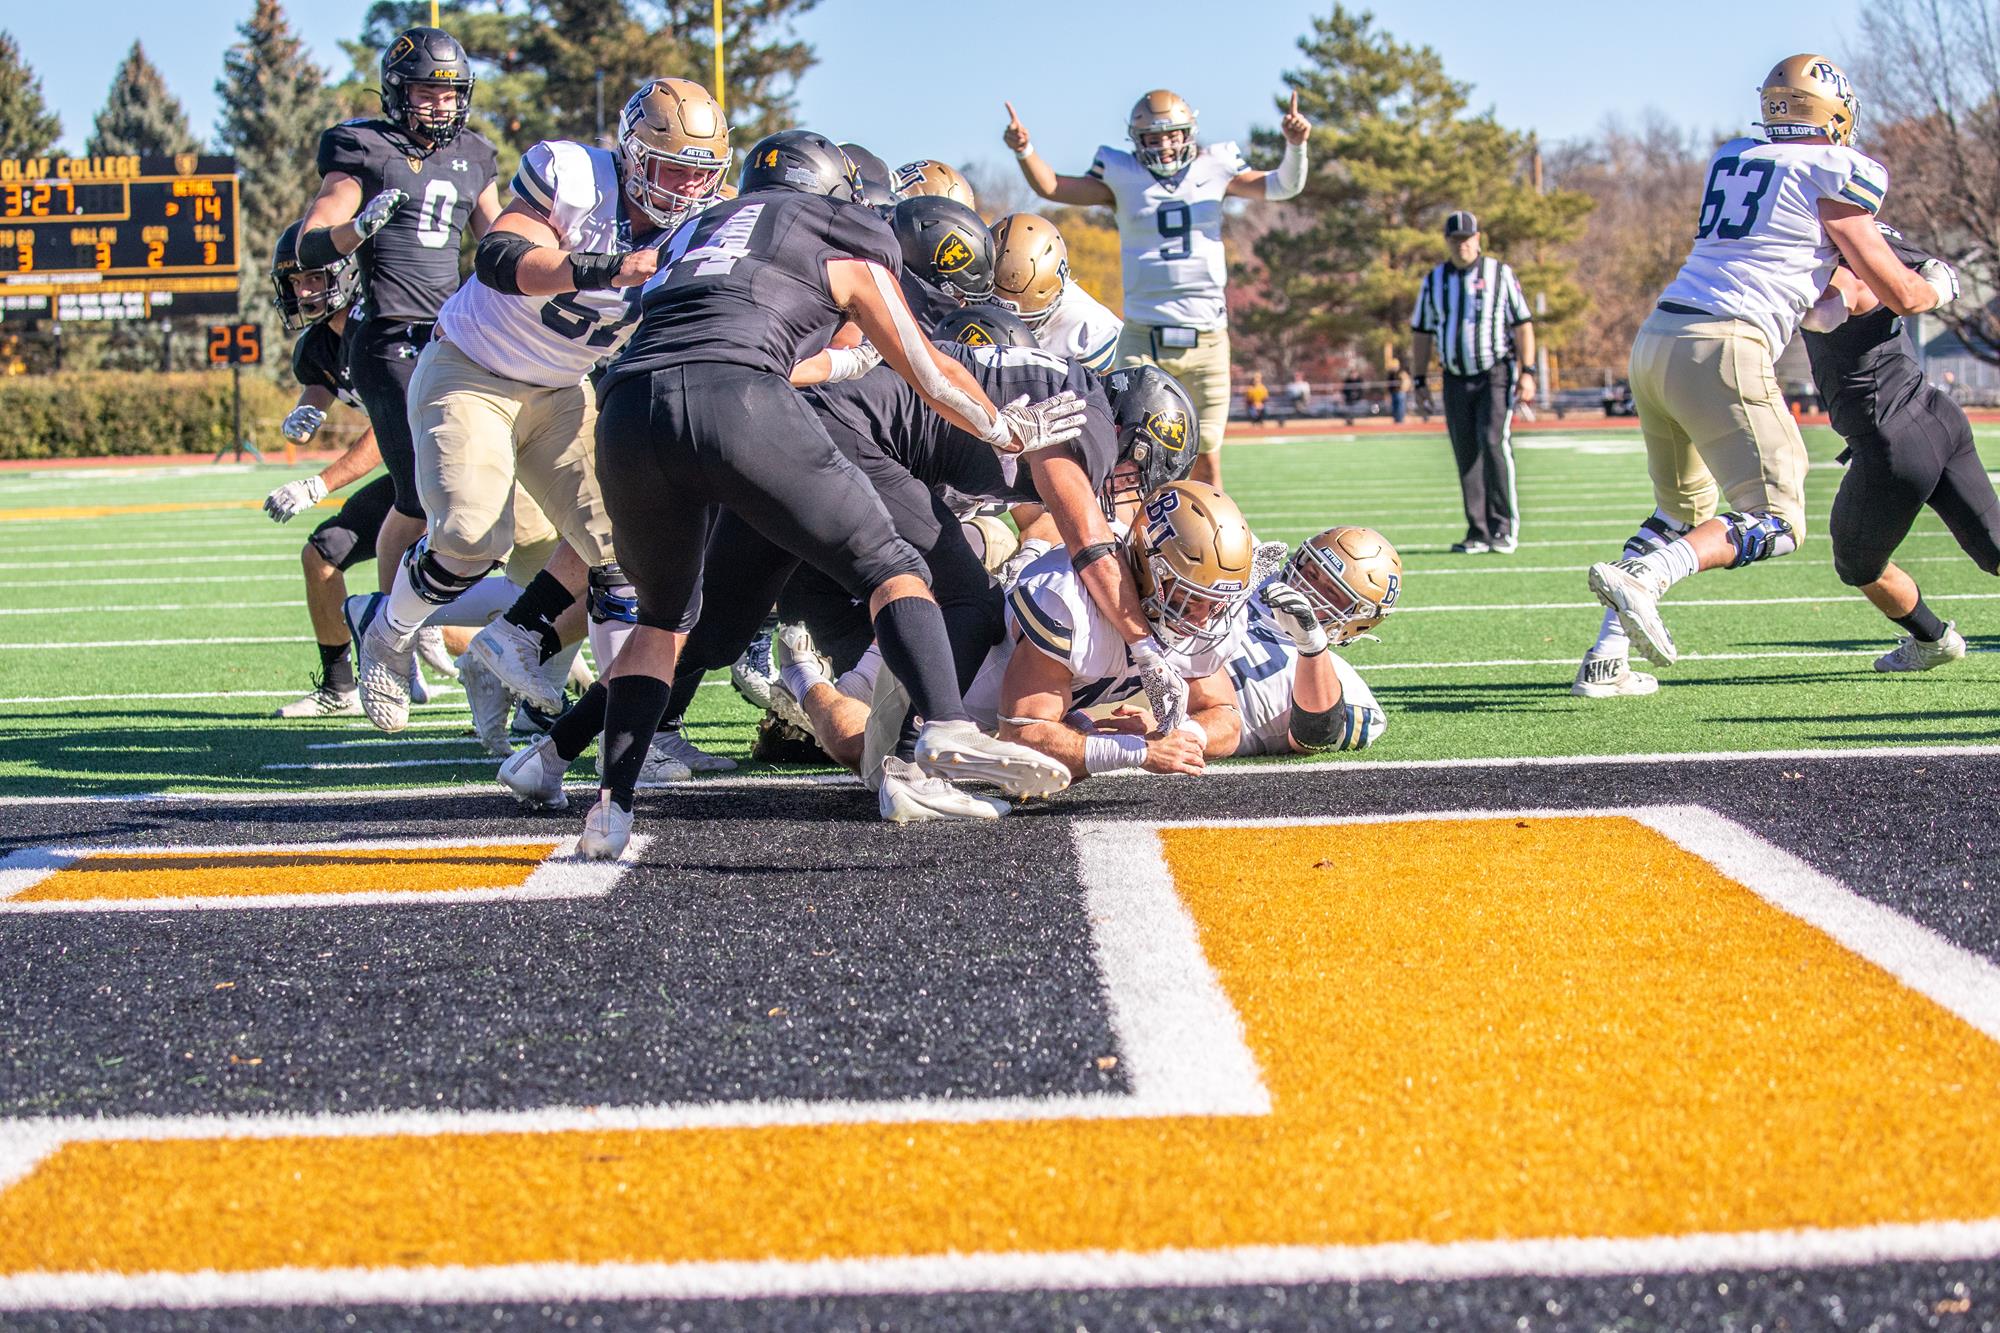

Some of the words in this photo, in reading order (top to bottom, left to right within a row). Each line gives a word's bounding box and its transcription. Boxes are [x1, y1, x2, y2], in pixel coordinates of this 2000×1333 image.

[1774, 126, 1791, 135] THE
[1791, 126, 1817, 136] ROPE
[0, 158, 51, 180] OLAF
[56, 154, 142, 180] COLLEGE
[686, 148, 712, 158] BETHEL
[754, 149, 779, 169] 14
[195, 196, 222, 222] 14
[1696, 155, 1777, 240] 63
[416, 179, 458, 249] 0
[1157, 200, 1191, 261] 9
[17, 243, 34, 273] 3
[95, 241, 112, 271] 3
[146, 239, 165, 269] 2
[209, 325, 261, 364] 25
[1323, 547, 1343, 570] BETHEL
[1583, 657, 1621, 683] NIKE
